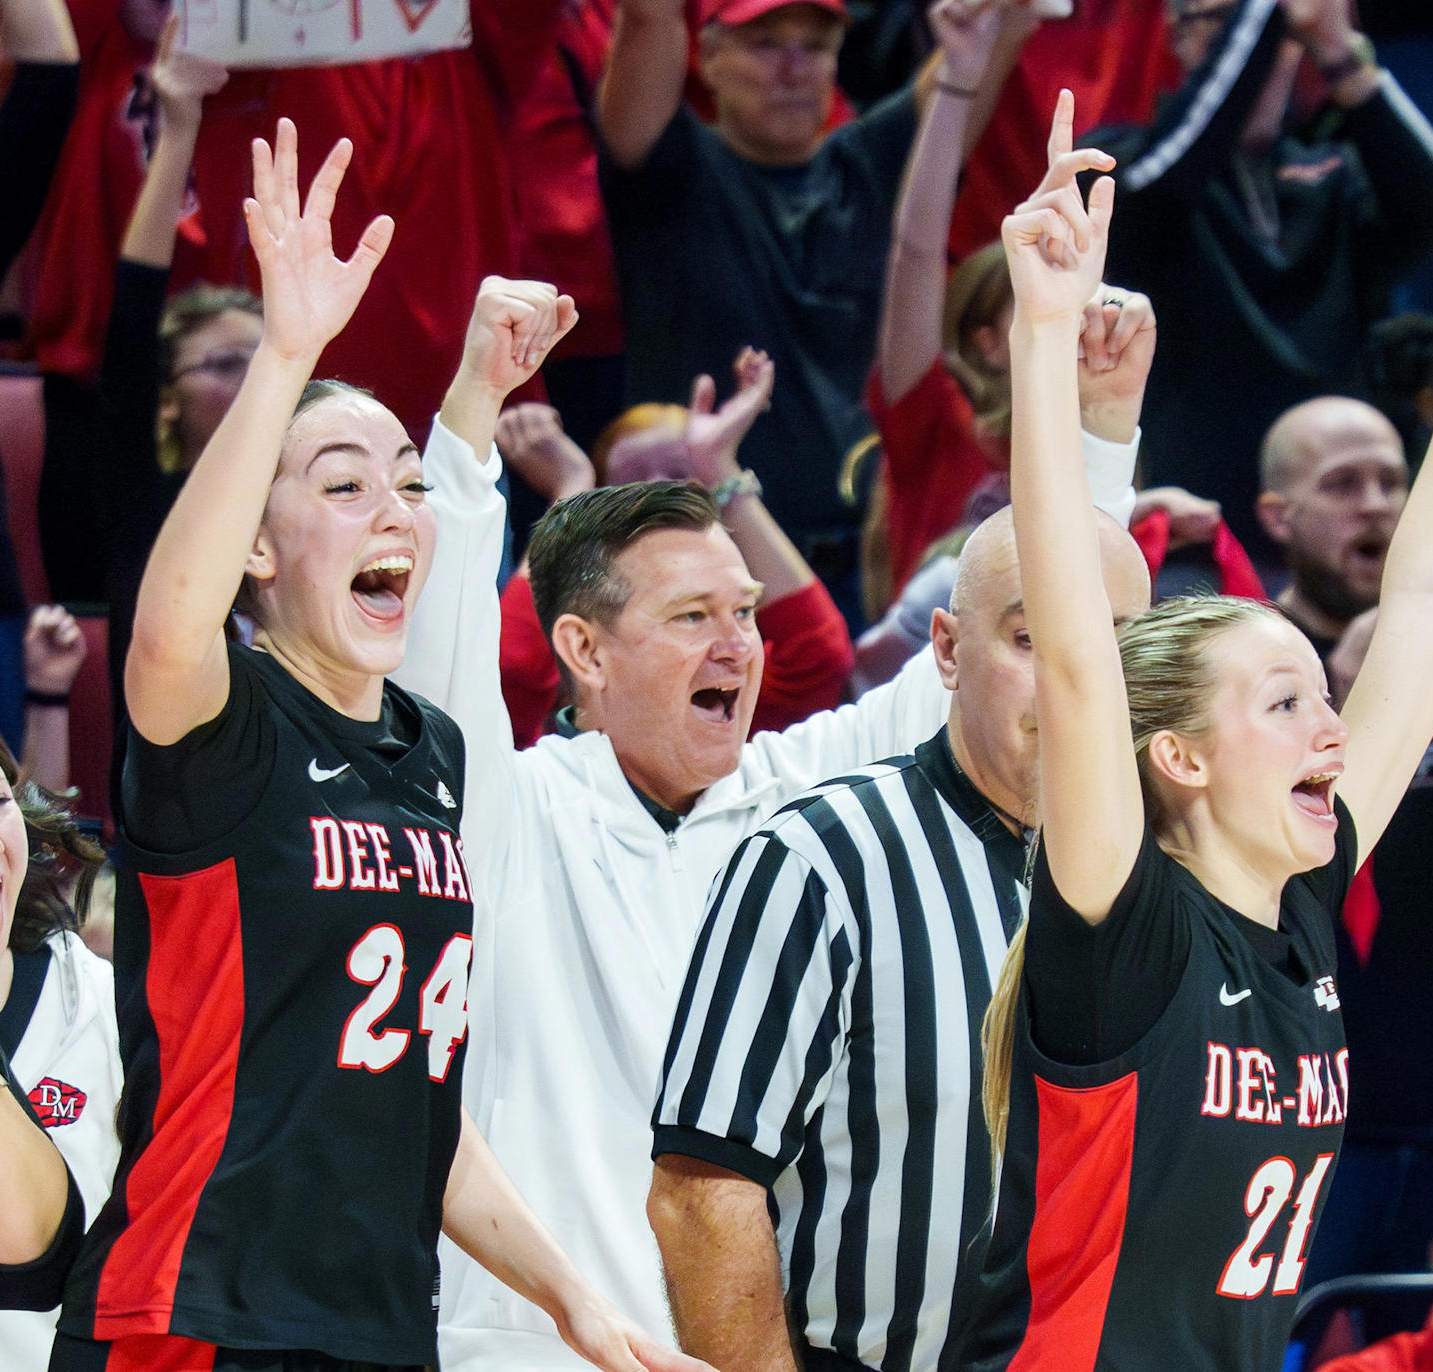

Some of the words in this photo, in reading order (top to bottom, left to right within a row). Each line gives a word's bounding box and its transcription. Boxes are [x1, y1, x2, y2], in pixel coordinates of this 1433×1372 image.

[309, 816, 474, 903] DEE-MA
[337, 922, 473, 1083] 24
[1215, 1153, 1335, 1300] 21
